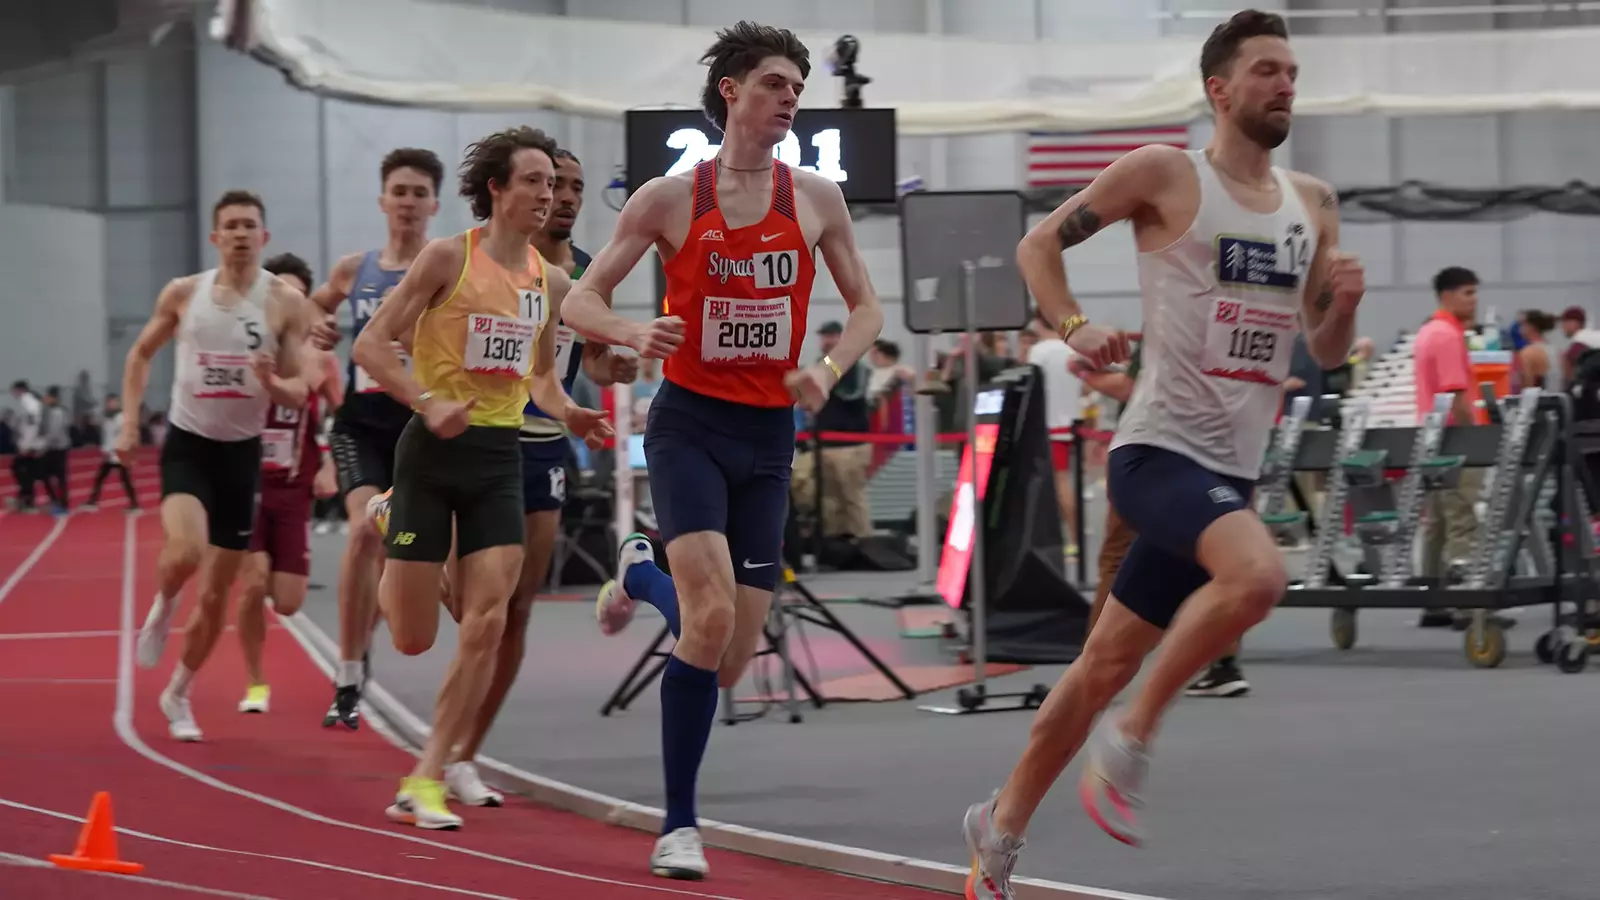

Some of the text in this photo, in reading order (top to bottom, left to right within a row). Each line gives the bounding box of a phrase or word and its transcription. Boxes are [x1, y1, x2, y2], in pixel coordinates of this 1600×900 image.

[708, 251, 755, 285] Syrac
[762, 252, 792, 286] 10
[525, 292, 542, 321] 11
[709, 300, 731, 317] BU
[245, 321, 262, 350] 5
[718, 321, 777, 348] 2038
